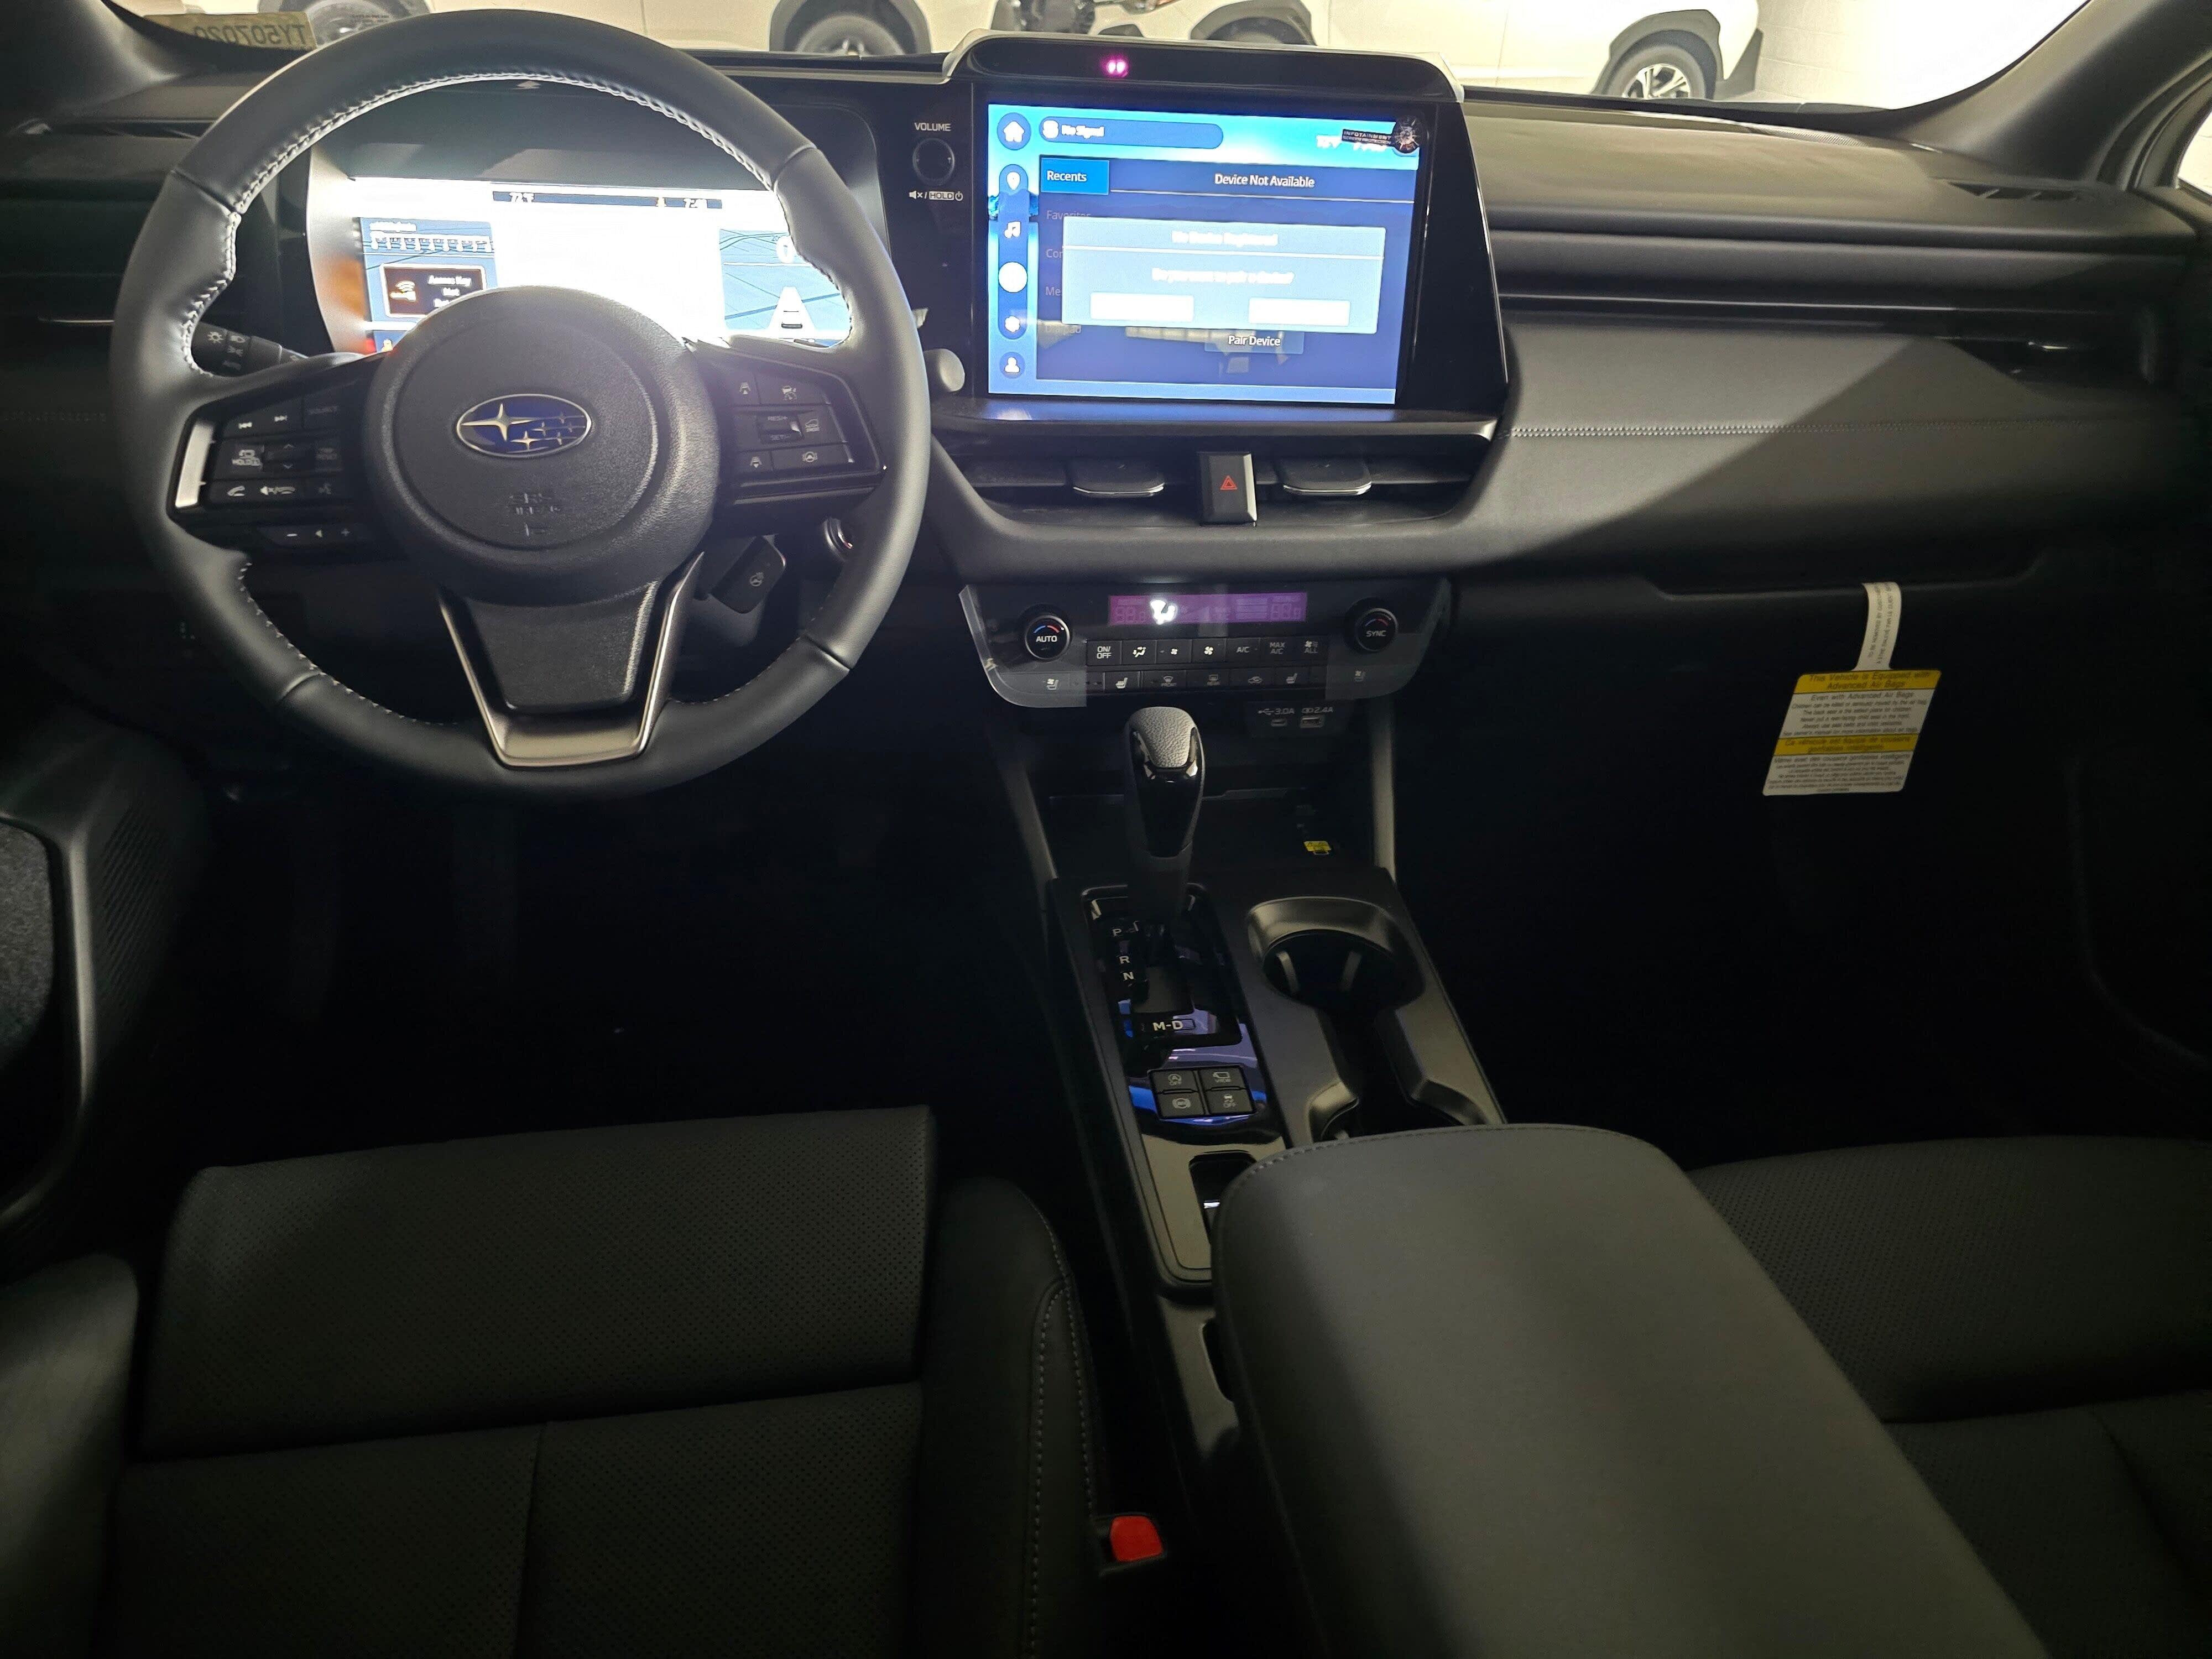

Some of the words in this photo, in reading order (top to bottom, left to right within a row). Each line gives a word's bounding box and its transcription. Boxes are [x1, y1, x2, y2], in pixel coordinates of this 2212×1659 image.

[914, 122, 951, 131] VOLUME
[1047, 170, 1087, 182] Recents
[1214, 173, 1248, 185] Device
[1249, 175, 1269, 186] Not
[1269, 175, 1316, 188] Available
[929, 191, 954, 200] HOLD
[1228, 335, 1248, 345] Pair
[1249, 336, 1281, 346] Device
[1827, 681, 1868, 690] Advanced
[1113, 928, 1122, 937] P
[1119, 956, 1130, 964] R
[1123, 972, 1134, 980] N
[1153, 1020, 1183, 1031] M-D
